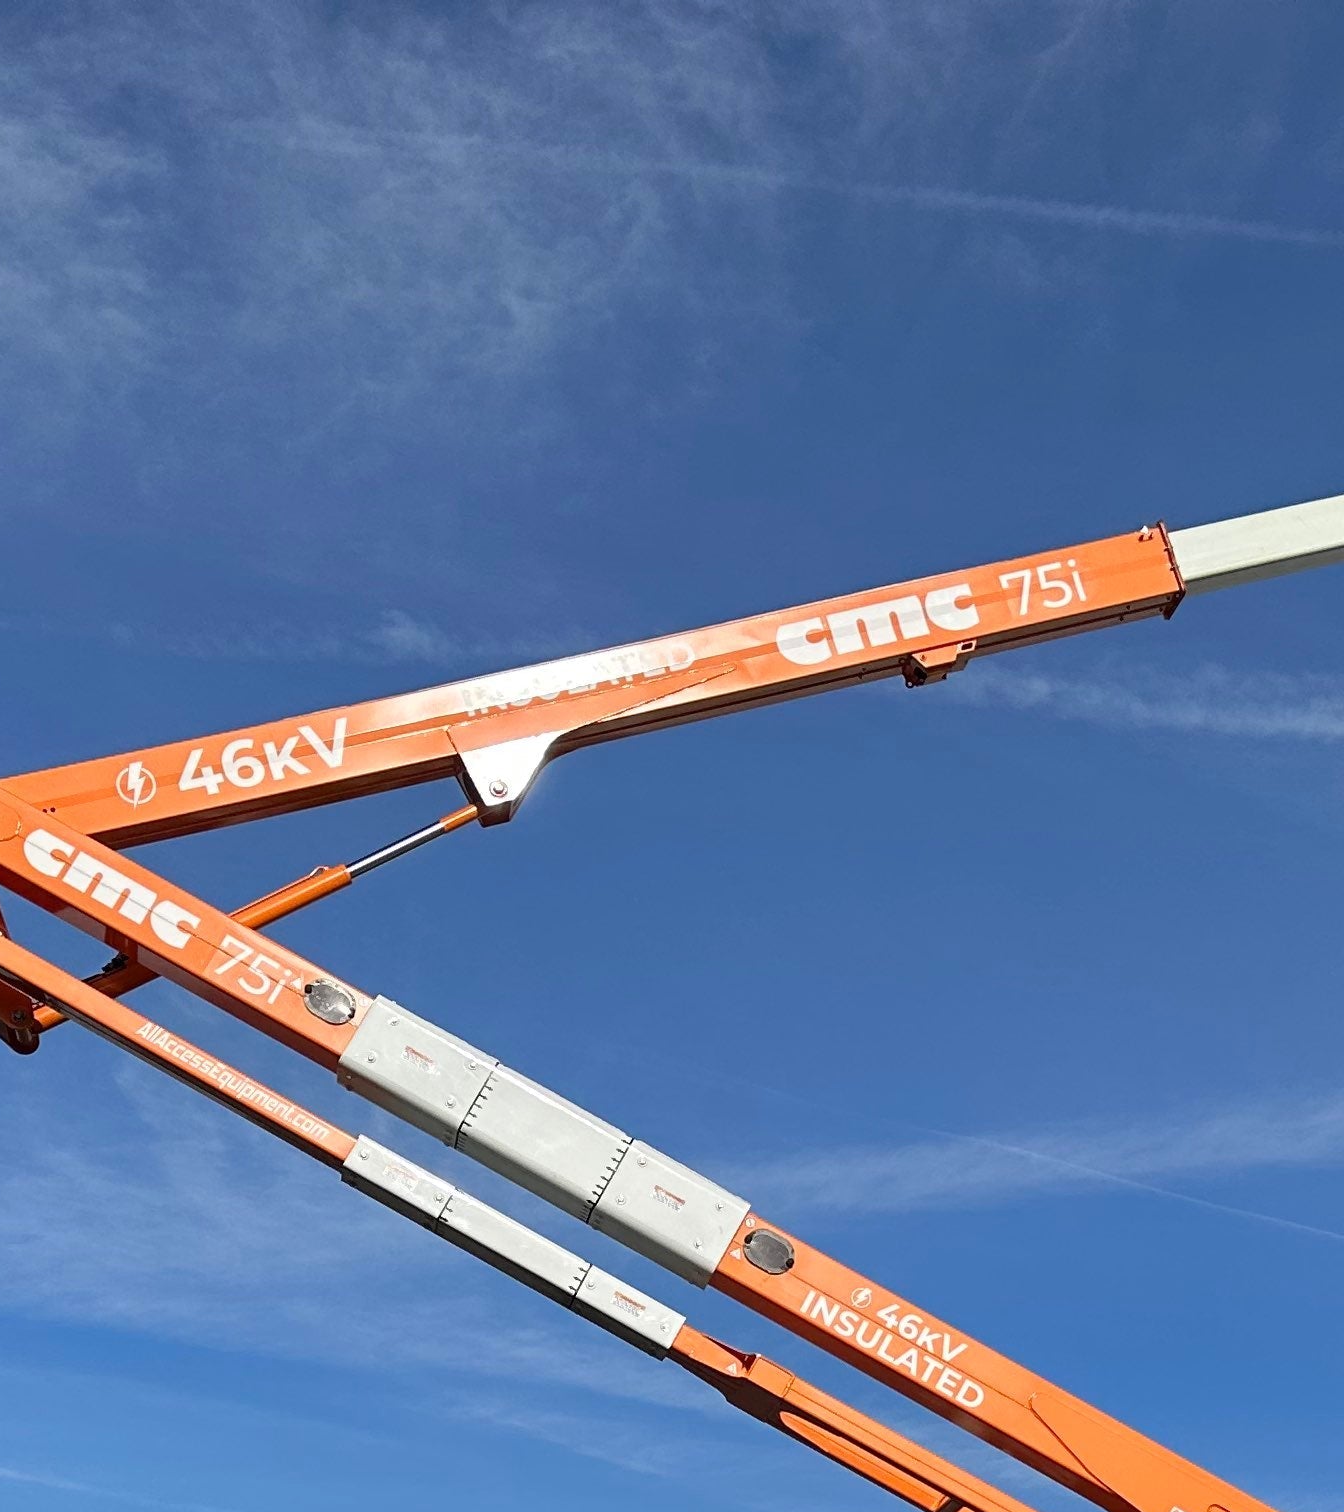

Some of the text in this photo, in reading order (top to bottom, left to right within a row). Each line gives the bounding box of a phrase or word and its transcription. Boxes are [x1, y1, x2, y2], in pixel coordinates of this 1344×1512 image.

[775, 558, 1087, 667] cmc 75i
[21, 828, 296, 1008] cmc 75i
[135, 1021, 331, 1141] AllAccessEquipment.com
[799, 1289, 986, 1411] INSULATED
